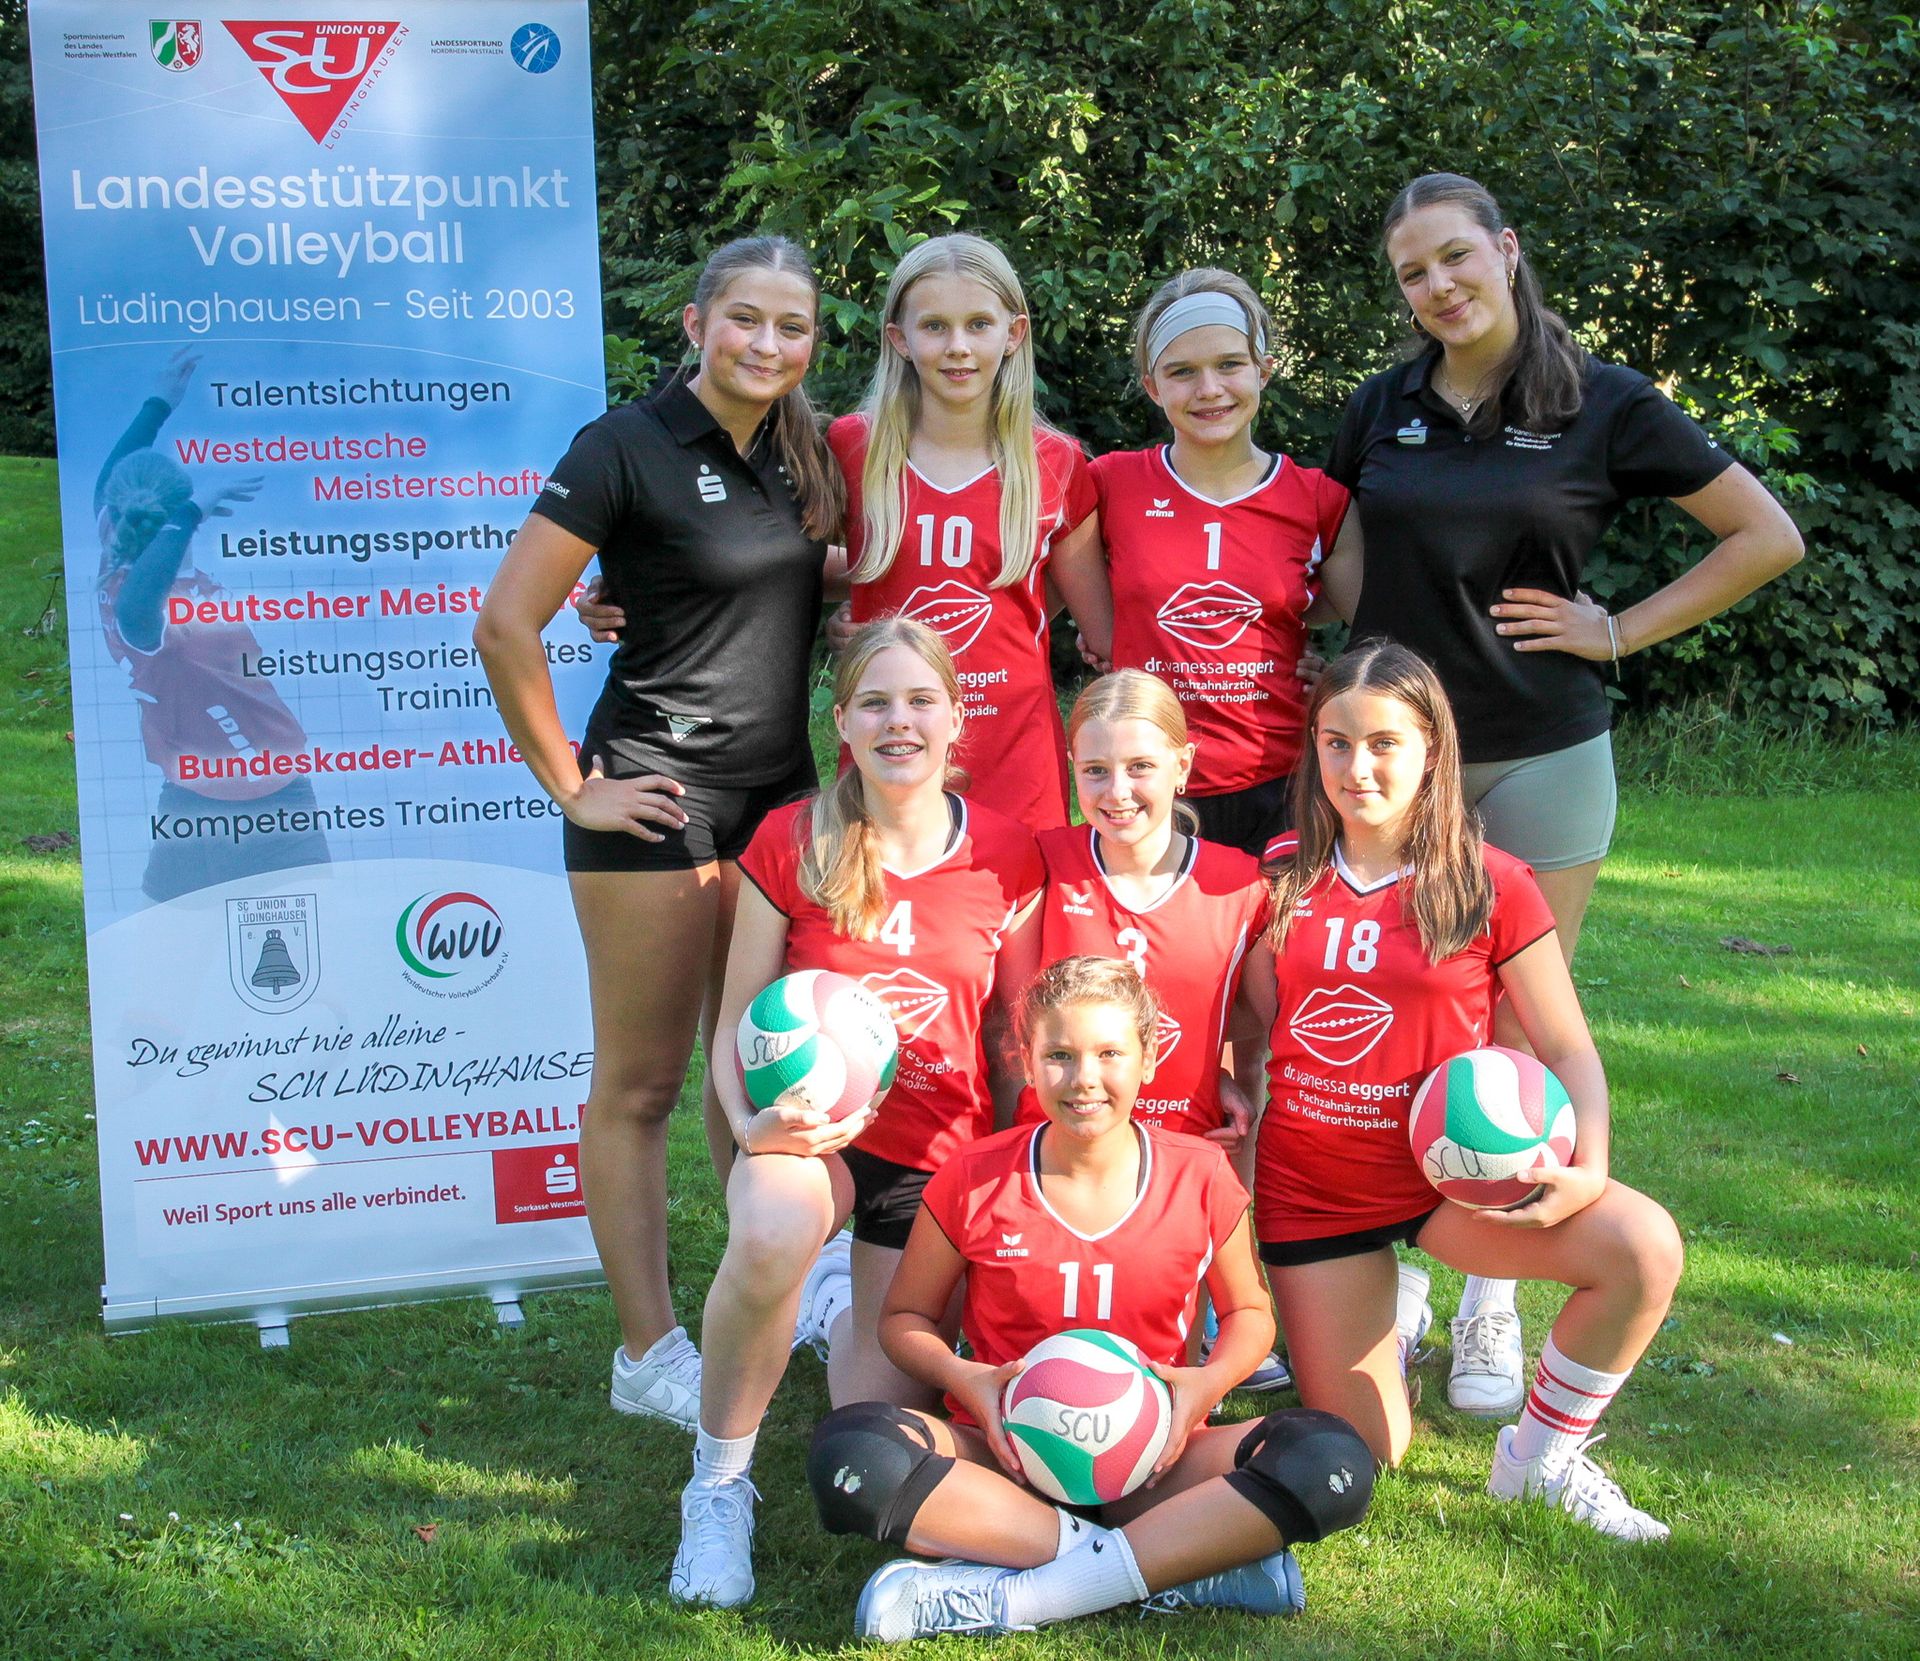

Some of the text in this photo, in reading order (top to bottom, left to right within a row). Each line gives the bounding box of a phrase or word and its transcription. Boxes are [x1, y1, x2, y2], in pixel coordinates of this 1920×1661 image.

[63, 33, 125, 41] Sportministerium
[315, 25, 386, 35] UNION 08
[430, 39, 503, 47] LANDESSPORTBUND
[64, 51, 138, 59] Nordrhein-Westfalen
[324, 25, 410, 150] LÜDINGHAUSEN
[72, 165, 570, 221] Landesstützpunkt
[188, 221, 464, 278] Volleyball
[79, 291, 361, 334] Lüdinghausen
[406, 288, 474, 320] Seit
[485, 288, 575, 320] 2003
[210, 378, 511, 411] Talentsichtungen
[175, 432, 427, 465] Westdeutsche
[314, 468, 551, 502] Meisterschaft
[1145, 509, 1175, 518] erima
[916, 514, 973, 568] 10
[1203, 522, 1222, 570] 1
[168, 583, 481, 625] Deutscher Meist
[956, 668, 1009, 688] eggert
[1226, 659, 1275, 677] eggert
[377, 680, 500, 713] Trainin
[151, 804, 385, 845] Kompetentes
[237, 898, 306, 912] SC UNION 08
[237, 909, 307, 923] LÜDINGHAUSEN
[879, 900, 916, 956] 4
[1323, 917, 1381, 974] 18
[401, 969, 447, 999] Westdeutscher
[448, 963, 504, 999] Volleyball-Verband
[126, 1037, 178, 1068] Du
[177, 1024, 312, 1078] gewinnst
[314, 1024, 352, 1054] nie
[360, 1013, 447, 1053] alleine
[248, 1051, 594, 1103] SCU LÜDINGHAUSE
[1349, 1082, 1410, 1101] eggert
[1134, 1097, 1191, 1115] eggert
[1286, 1098, 1399, 1131] für Kieferorthopädie
[1298, 1090, 1381, 1115] Fachzahnärztin
[162, 1183, 467, 1231] Weil Sport uns alle verbindet.
[513, 1203, 550, 1213] Sparkasse
[996, 1247, 1029, 1258] erima
[1058, 1260, 1114, 1321] 11
[1052, 1408, 1111, 1444] SCU
